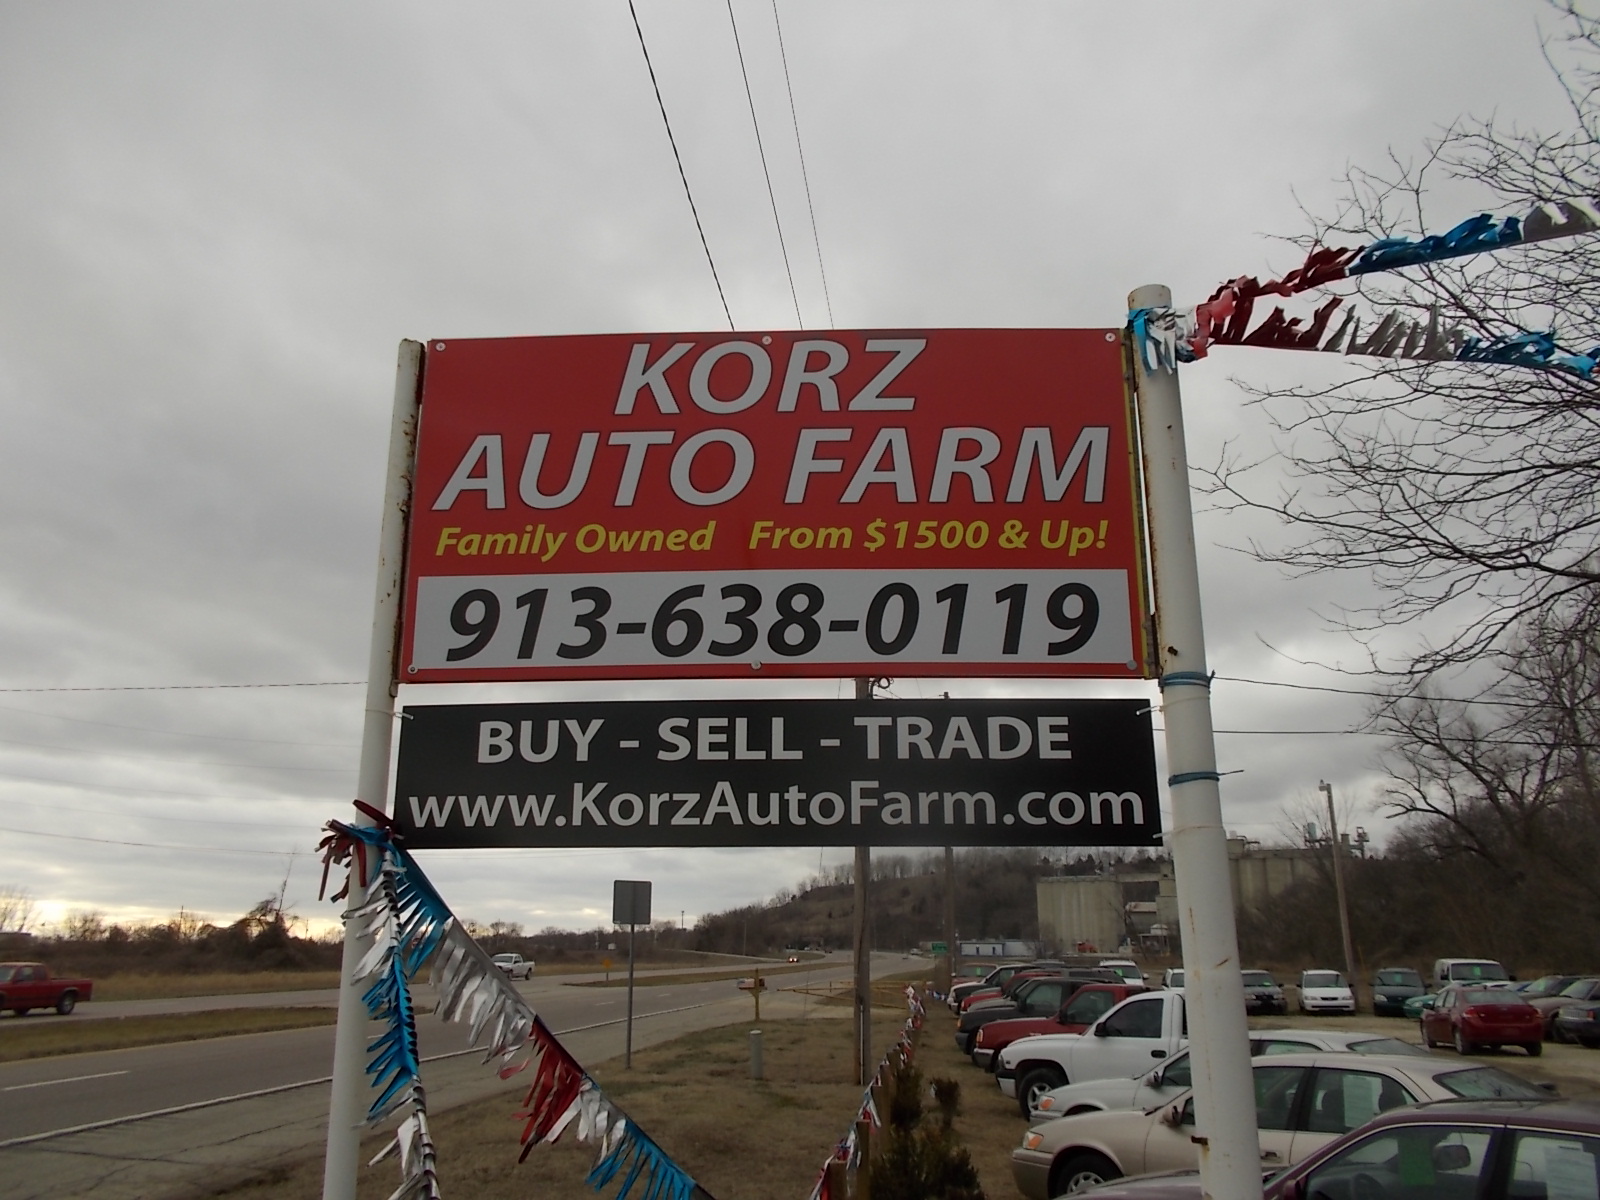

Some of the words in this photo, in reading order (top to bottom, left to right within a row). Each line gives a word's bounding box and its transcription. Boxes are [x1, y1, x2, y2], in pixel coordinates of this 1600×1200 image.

[614, 338, 927, 415] KORZ
[431, 428, 755, 510] AUTO
[784, 426, 1110, 503] FARM
[435, 524, 567, 563] Family
[575, 520, 717, 554] Owned
[748, 520, 853, 550] From
[863, 518, 990, 552] $1500
[998, 519, 1030, 549] &
[1040, 519, 1109, 556] Up!
[446, 582, 1100, 662] 913-638-0119
[477, 719, 605, 764] BUY
[619, 739, 640, 749] -
[657, 716, 803, 761] SELL
[820, 738, 841, 748] -
[854, 716, 1073, 760] TRADE
[408, 780, 1145, 828] www.KorzAutoFarm.com
